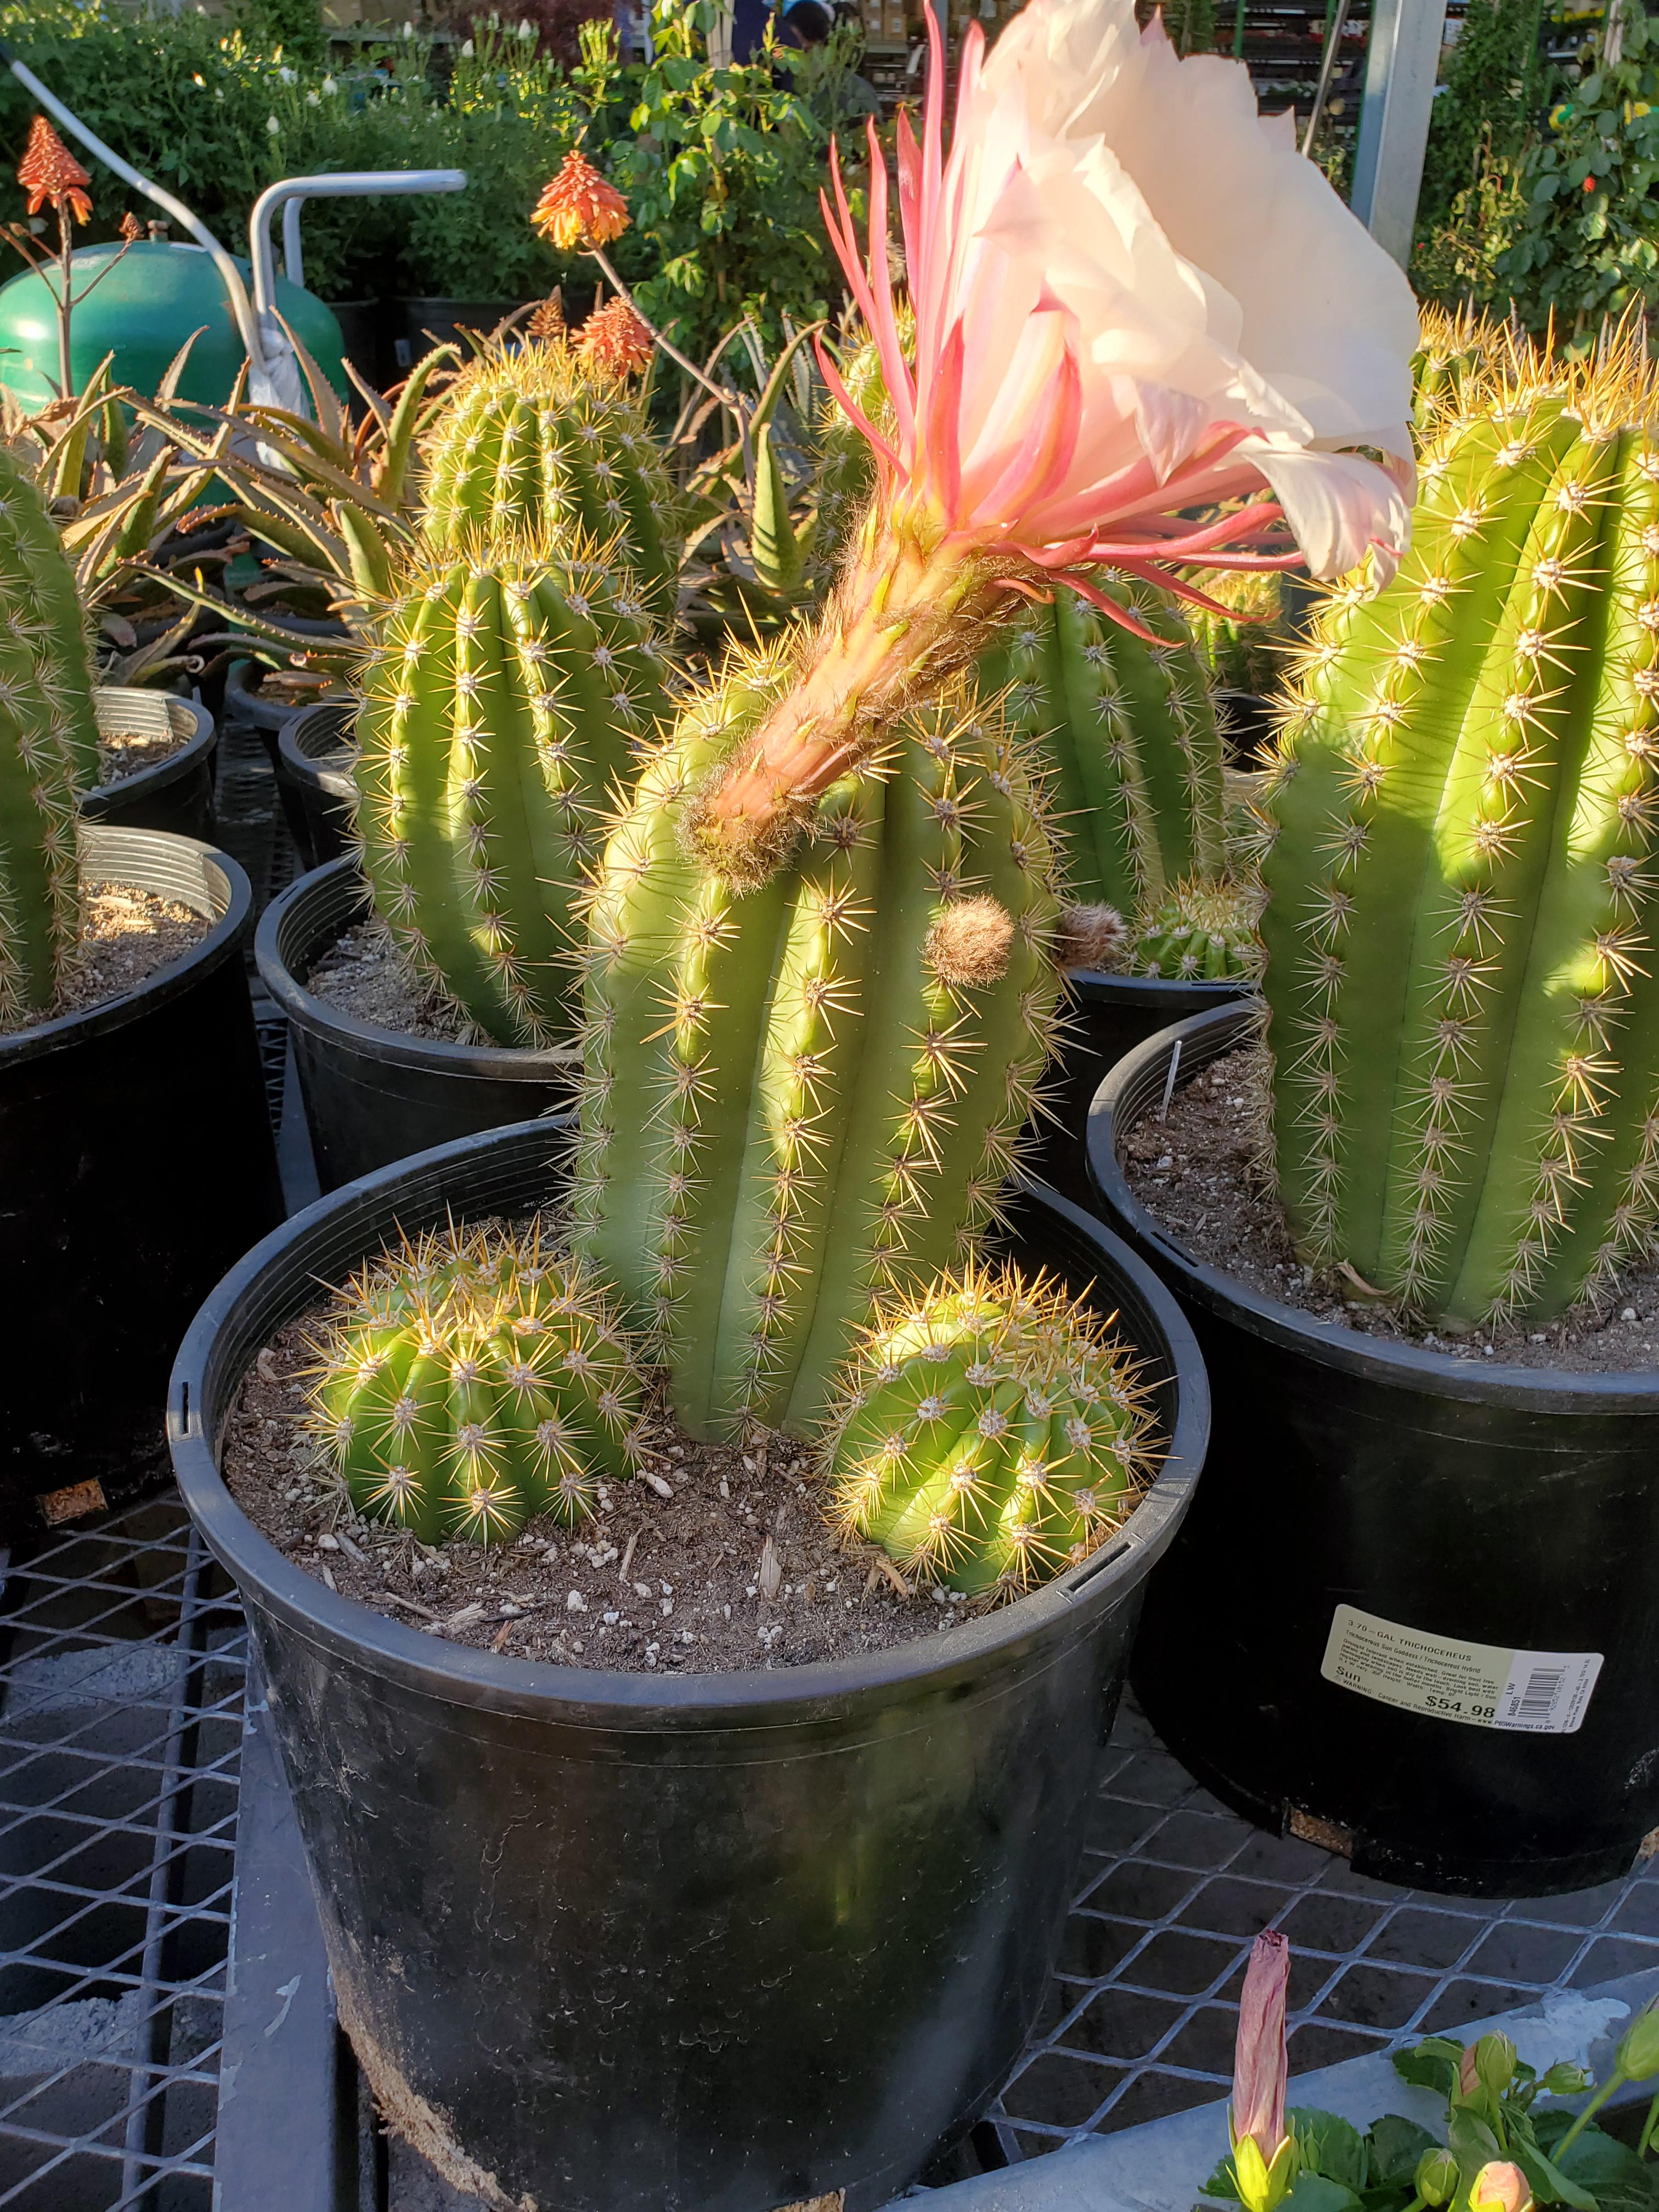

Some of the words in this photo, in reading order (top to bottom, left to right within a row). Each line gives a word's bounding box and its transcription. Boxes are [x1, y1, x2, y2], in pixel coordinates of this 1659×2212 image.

[1346, 1629, 1380, 1647] Trichocereus
[1394, 1647, 1418, 1660] Goddess
[1424, 1656, 1460, 1670] Trichocereus
[1462, 1665, 1481, 1673] Hybrid
[1400, 1638, 1472, 1661] TRICHOCEREUS
[1360, 1661, 1384, 1673] watering
[1389, 1656, 1404, 1664] when
[1336, 1666, 1361, 1682] Sun
[1505, 1682, 1516, 1695] LW
[1378, 1692, 1399, 1703] Cancer
[1413, 1703, 1453, 1718] Reproductive
[1425, 1696, 1496, 1718] $54.98
